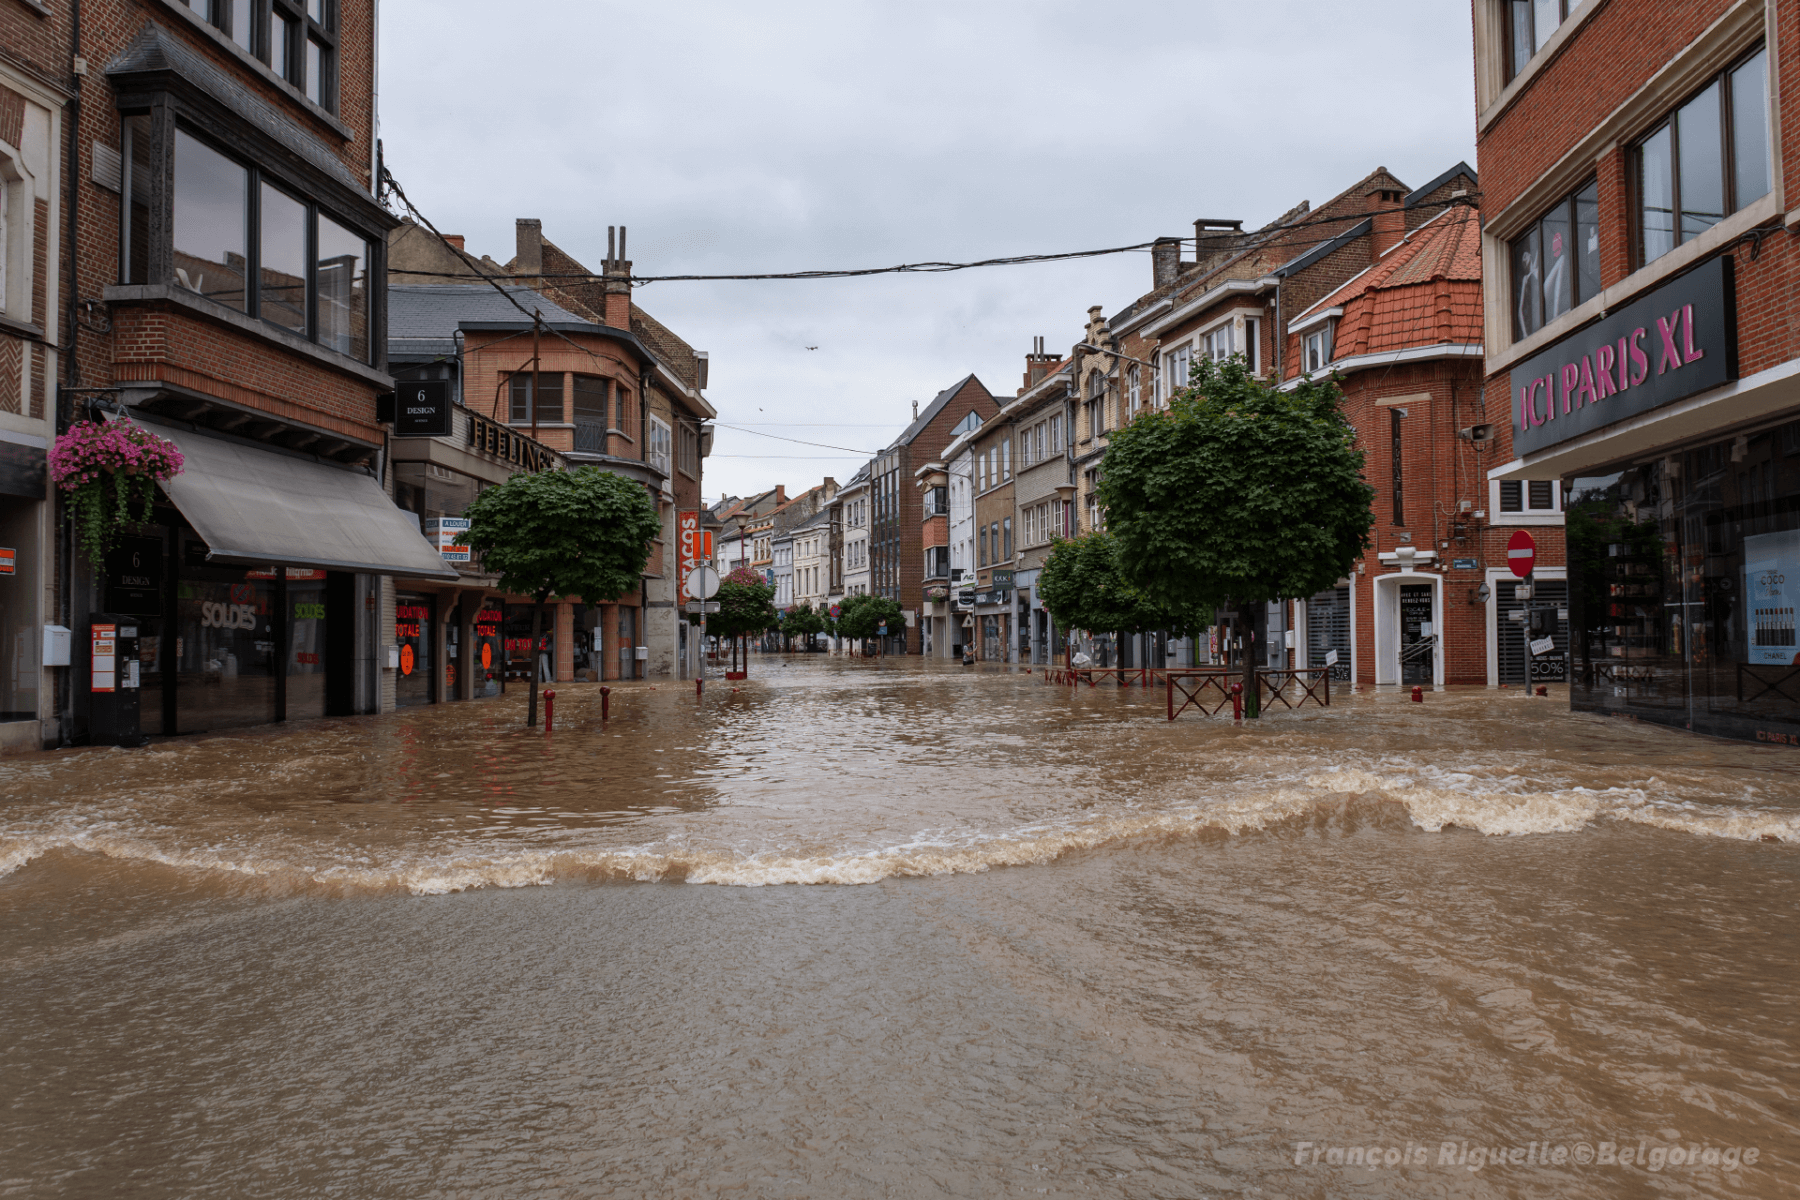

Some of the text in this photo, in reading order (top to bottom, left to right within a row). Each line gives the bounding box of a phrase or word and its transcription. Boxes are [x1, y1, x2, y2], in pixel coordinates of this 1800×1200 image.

[1519, 303, 1704, 431] ICI PARIS XL
[417, 389, 426, 402] 6
[407, 406, 436, 415] DESIGN
[132, 551, 141, 568] 6
[121, 575, 151, 586] DESIGN
[1760, 574, 1785, 586] COCO
[201, 601, 257, 631] SOLDES
[294, 602, 326, 620] SOLDES
[395, 623, 420, 637] TOTALE
[476, 624, 496, 637] TOTALE
[517, 638, 547, 651] TOTE
[297, 652, 320, 665] SOLDES
[1763, 651, 1787, 660] CHANEL
[1767, 731, 1788, 744] PARIS
